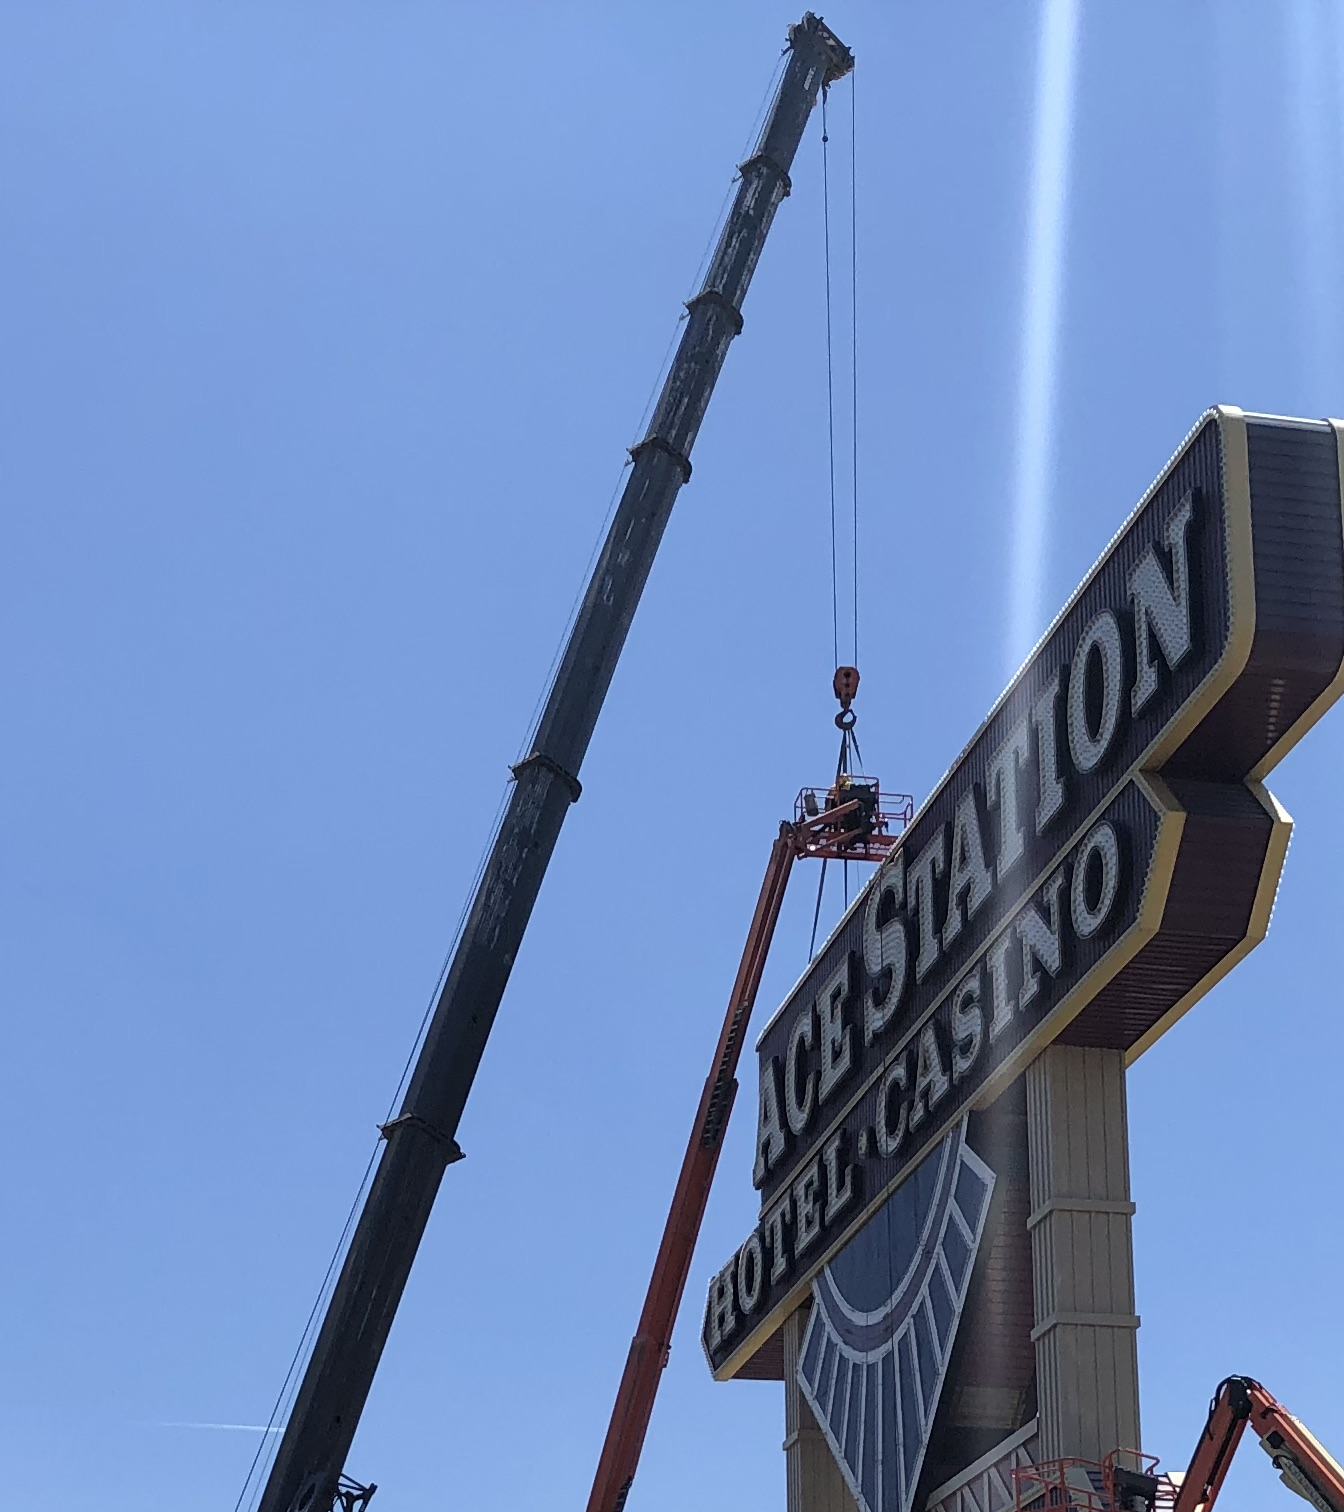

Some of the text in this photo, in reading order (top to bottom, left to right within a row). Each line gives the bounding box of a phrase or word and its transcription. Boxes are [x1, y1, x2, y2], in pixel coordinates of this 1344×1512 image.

[708, 820, 1120, 1350] HOTEL CASINO
[755, 489, 1193, 1184] ACE STATION
